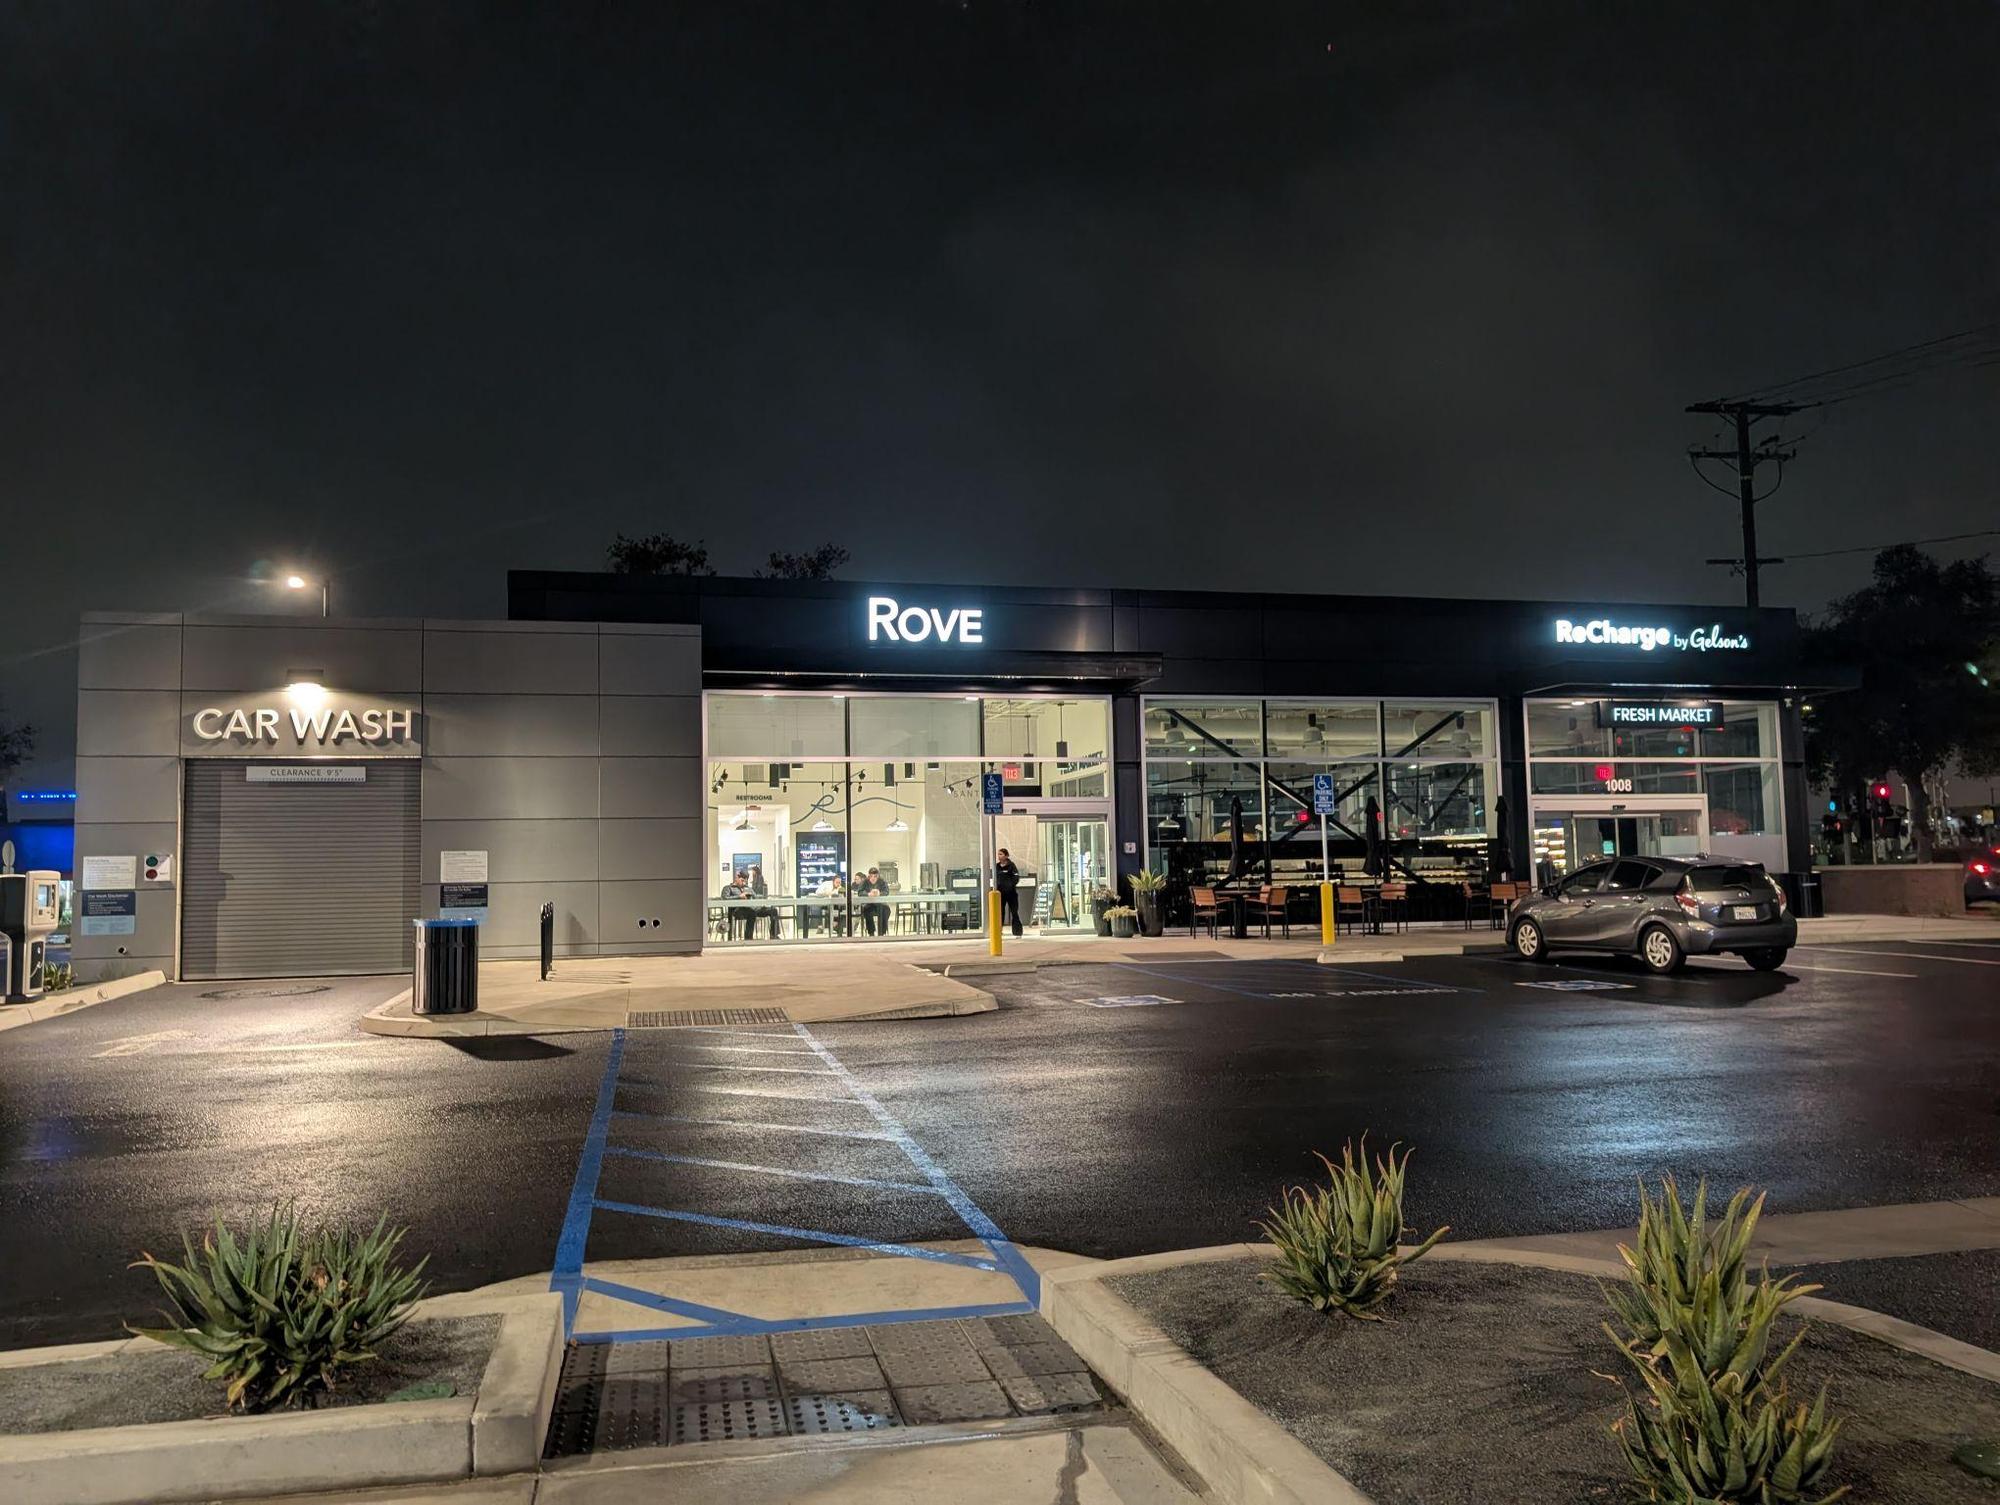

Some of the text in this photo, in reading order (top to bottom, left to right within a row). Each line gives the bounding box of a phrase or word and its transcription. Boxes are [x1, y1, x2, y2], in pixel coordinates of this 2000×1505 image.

[868, 597, 983, 643] ROVE
[1556, 619, 1749, 652] ReCharge by Gelson's
[193, 708, 412, 740] CAR WASH
[1613, 707, 1713, 723] FRESH MARKET
[270, 768, 322, 777] CLEARANCE
[1605, 778, 1633, 792] 1008
